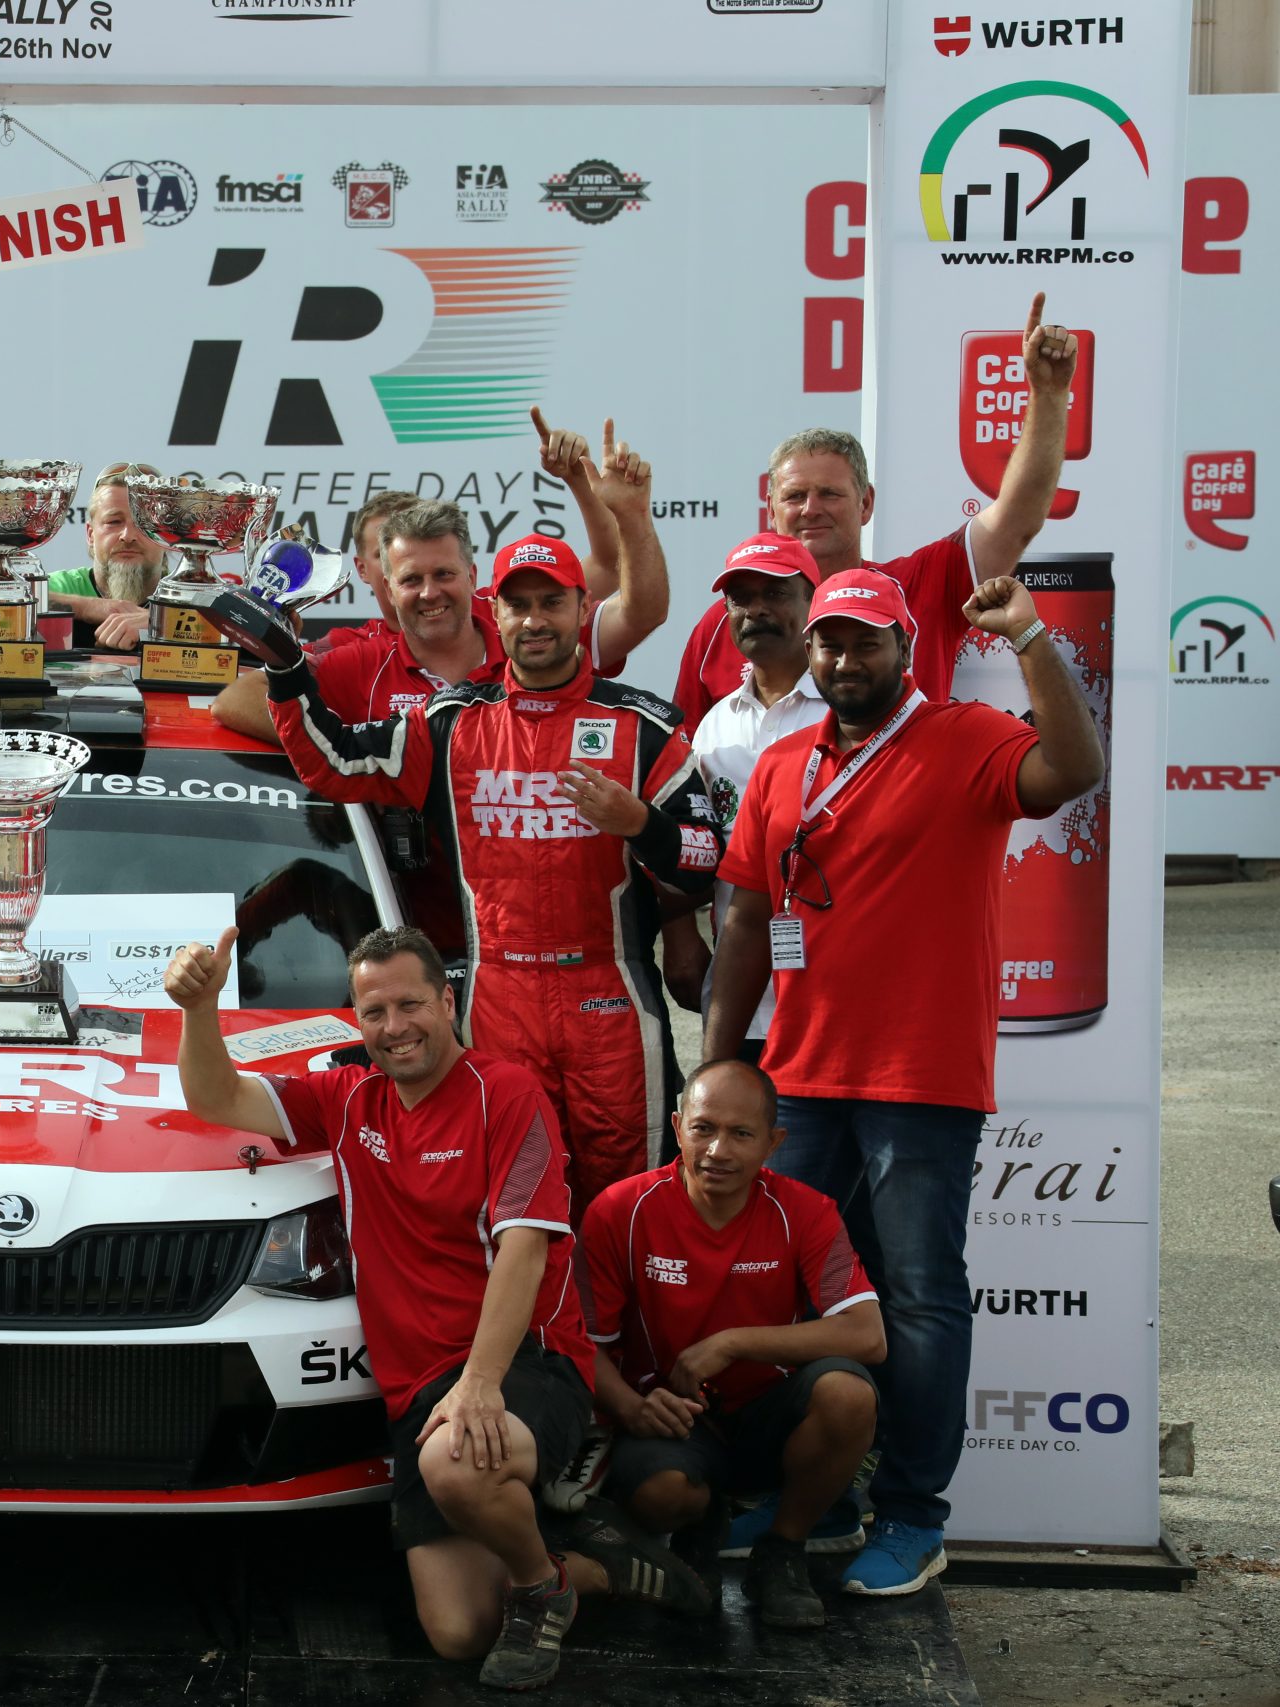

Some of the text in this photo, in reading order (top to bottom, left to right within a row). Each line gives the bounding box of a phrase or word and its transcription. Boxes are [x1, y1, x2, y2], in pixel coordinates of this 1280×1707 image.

[982, 18, 1123, 49] WÜRTH
[62, 38, 112, 58] Nov
[456, 200, 508, 212] RALLY
[941, 247, 1134, 264] www.RRPM.co
[650, 501, 719, 518] ÜRTH
[514, 544, 553, 556] MRF
[730, 545, 778, 564] MRF
[510, 555, 557, 567] ŠKODA
[1025, 573, 1074, 587] ENERGY
[825, 587, 879, 603] MRF
[515, 698, 560, 712] MRF
[579, 721, 612, 729] ŠKODA
[1167, 766, 1280, 791] MRF
[471, 805, 602, 840] TYRES
[504, 950, 555, 962] Gaurav Gill
[580, 997, 630, 1011] chicane
[285, 1041, 306, 1051] GPS
[307, 1033, 349, 1047] Tracking
[982, 1119, 1043, 1148] the
[966, 1212, 1062, 1227] ESORTS
[645, 1266, 688, 1286] TYRES
[1021, 1440, 1049, 1451] DAY
[1053, 1440, 1081, 1452] CO.
